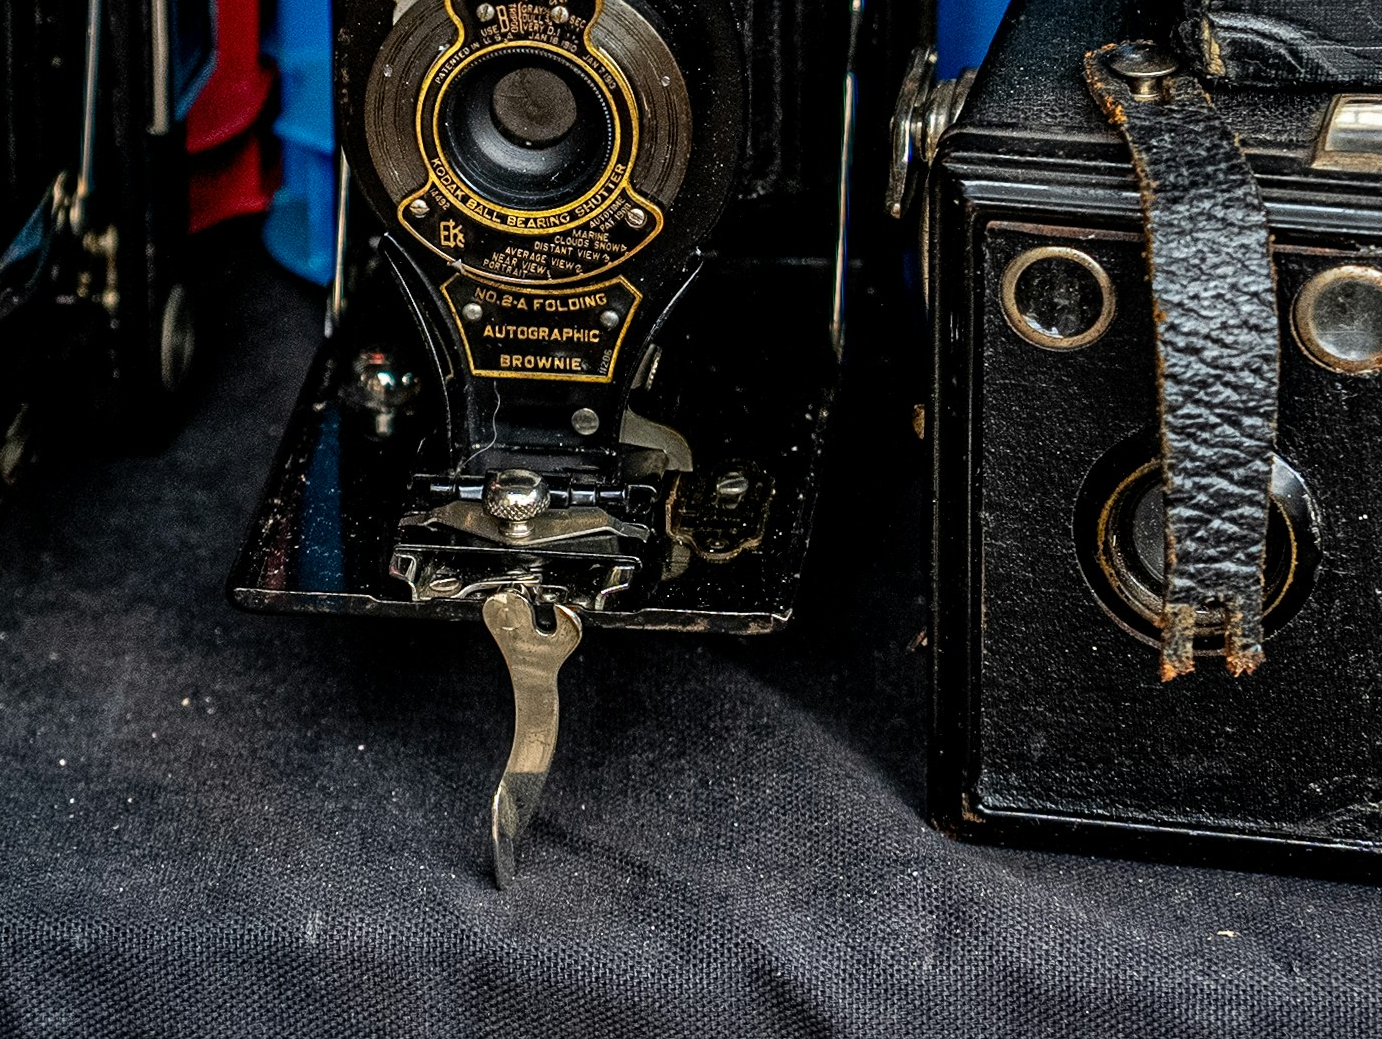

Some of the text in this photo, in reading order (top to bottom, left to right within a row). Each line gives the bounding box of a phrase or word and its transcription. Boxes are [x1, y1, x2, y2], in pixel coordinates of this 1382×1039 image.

[480, 24, 500, 37] USE
[434, 46, 470, 84] PATENTED
[431, 158, 626, 228] KODAK BALL BEARING SHUTTER
[588, 196, 626, 228] AUTOTIME
[554, 235, 589, 248] CLOUDS
[594, 242, 621, 252] SNOW
[572, 228, 610, 242] MARINE
[505, 247, 547, 263] AVERAGE
[551, 257, 575, 269] VIEW
[534, 241, 574, 255] DISTANT
[577, 249, 601, 260] VIEW
[483, 258, 529, 278] PORTRAIT
[492, 252, 517, 266] NEAR
[522, 261, 547, 274] VIEW
[533, 292, 607, 311] FOLDING
[483, 325, 600, 343] AUTOGRAPHIC
[500, 354, 582, 370] BROWNIE
